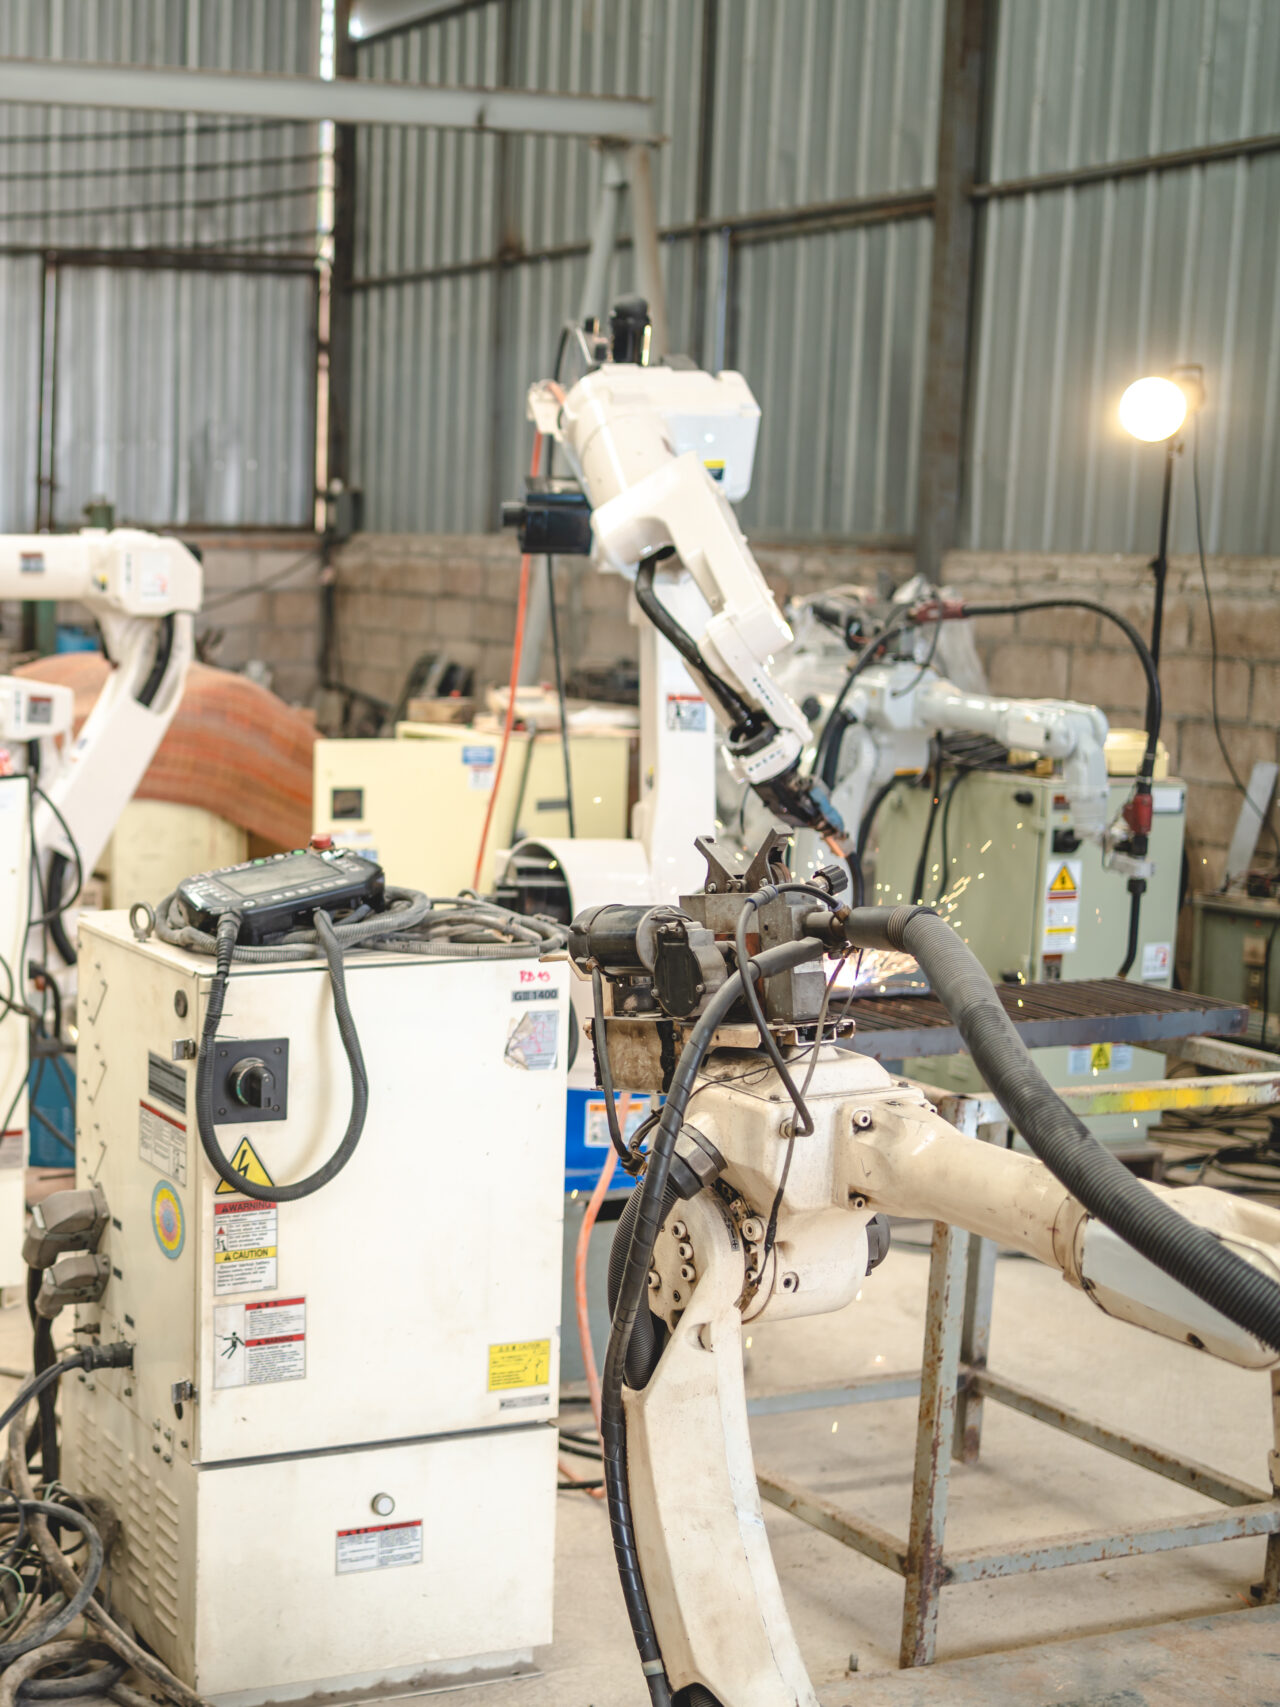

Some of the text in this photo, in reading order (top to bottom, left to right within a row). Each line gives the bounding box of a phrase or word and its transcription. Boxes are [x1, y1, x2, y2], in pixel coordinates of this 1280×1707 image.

[533, 989, 558, 1000] 1400
[228, 1201, 272, 1212] WARNING
[232, 1248, 269, 1260] CAUTION
